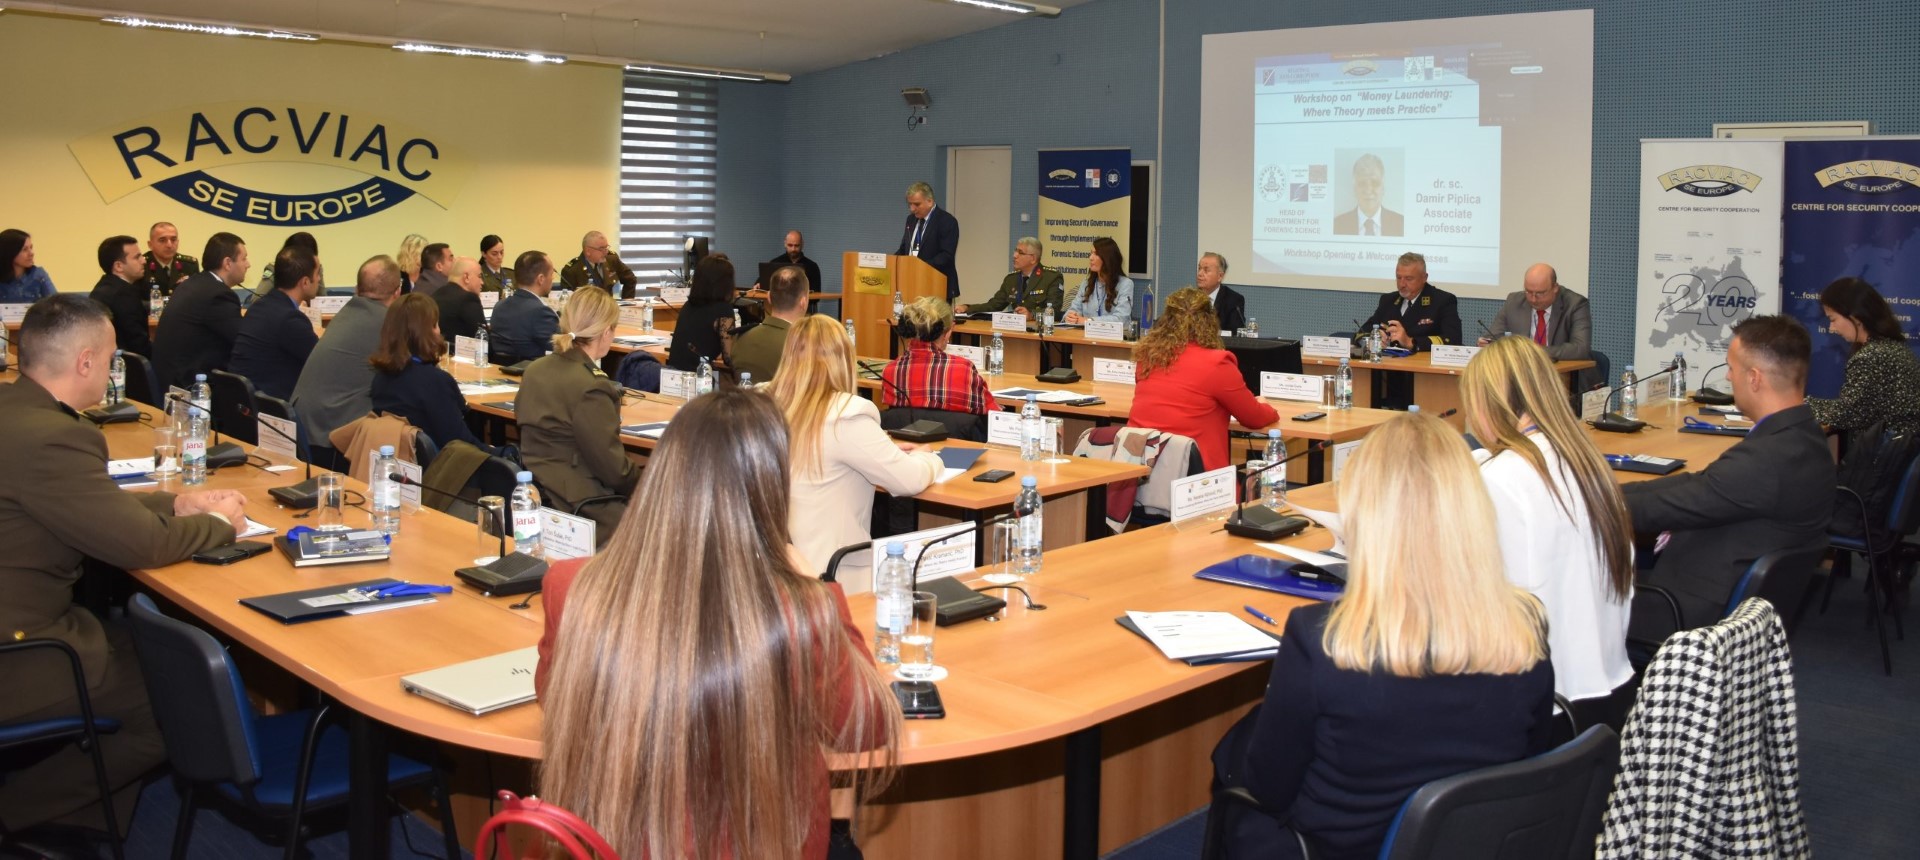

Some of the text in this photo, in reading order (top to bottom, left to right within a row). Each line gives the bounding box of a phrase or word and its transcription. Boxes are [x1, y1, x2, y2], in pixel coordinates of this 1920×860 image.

[1293, 94, 1338, 104] Workshop
[1340, 94, 1352, 102] on
[1395, 88, 1453, 101] Laundering:
[1303, 107, 1331, 117] Where
[1333, 106, 1365, 118] Theory
[1367, 106, 1395, 116] meets
[112, 107, 439, 182] RACVIAC
[1668, 167, 1750, 186] RACVIAC
[1826, 161, 1920, 182] RACVIAC
[1433, 178, 1464, 189] dr. sc.
[1683, 184, 1735, 195] SE EUROPE
[1843, 180, 1903, 193] SE EUROPE
[188, 180, 387, 222] SE EUROPE
[1416, 192, 1481, 206] Damir Piplica
[1424, 208, 1473, 219] Associate
[1791, 203, 1825, 211] CENTRE
[1827, 203, 1845, 211] FOR
[1846, 203, 1890, 212] SECURITY
[1045, 218, 1118, 227] Improving Security Governance
[1266, 217, 1306, 225] DEPARTMENT
[1424, 222, 1472, 234] professor
[1050, 234, 1069, 243] through
[1051, 250, 1072, 258] Forensic
[1284, 249, 1321, 259] Workshop
[1323, 249, 1355, 261] Opening
[1357, 251, 1364, 260] &
[1366, 251, 1398, 261] Welcom
[1707, 295, 1757, 309] YEARS
